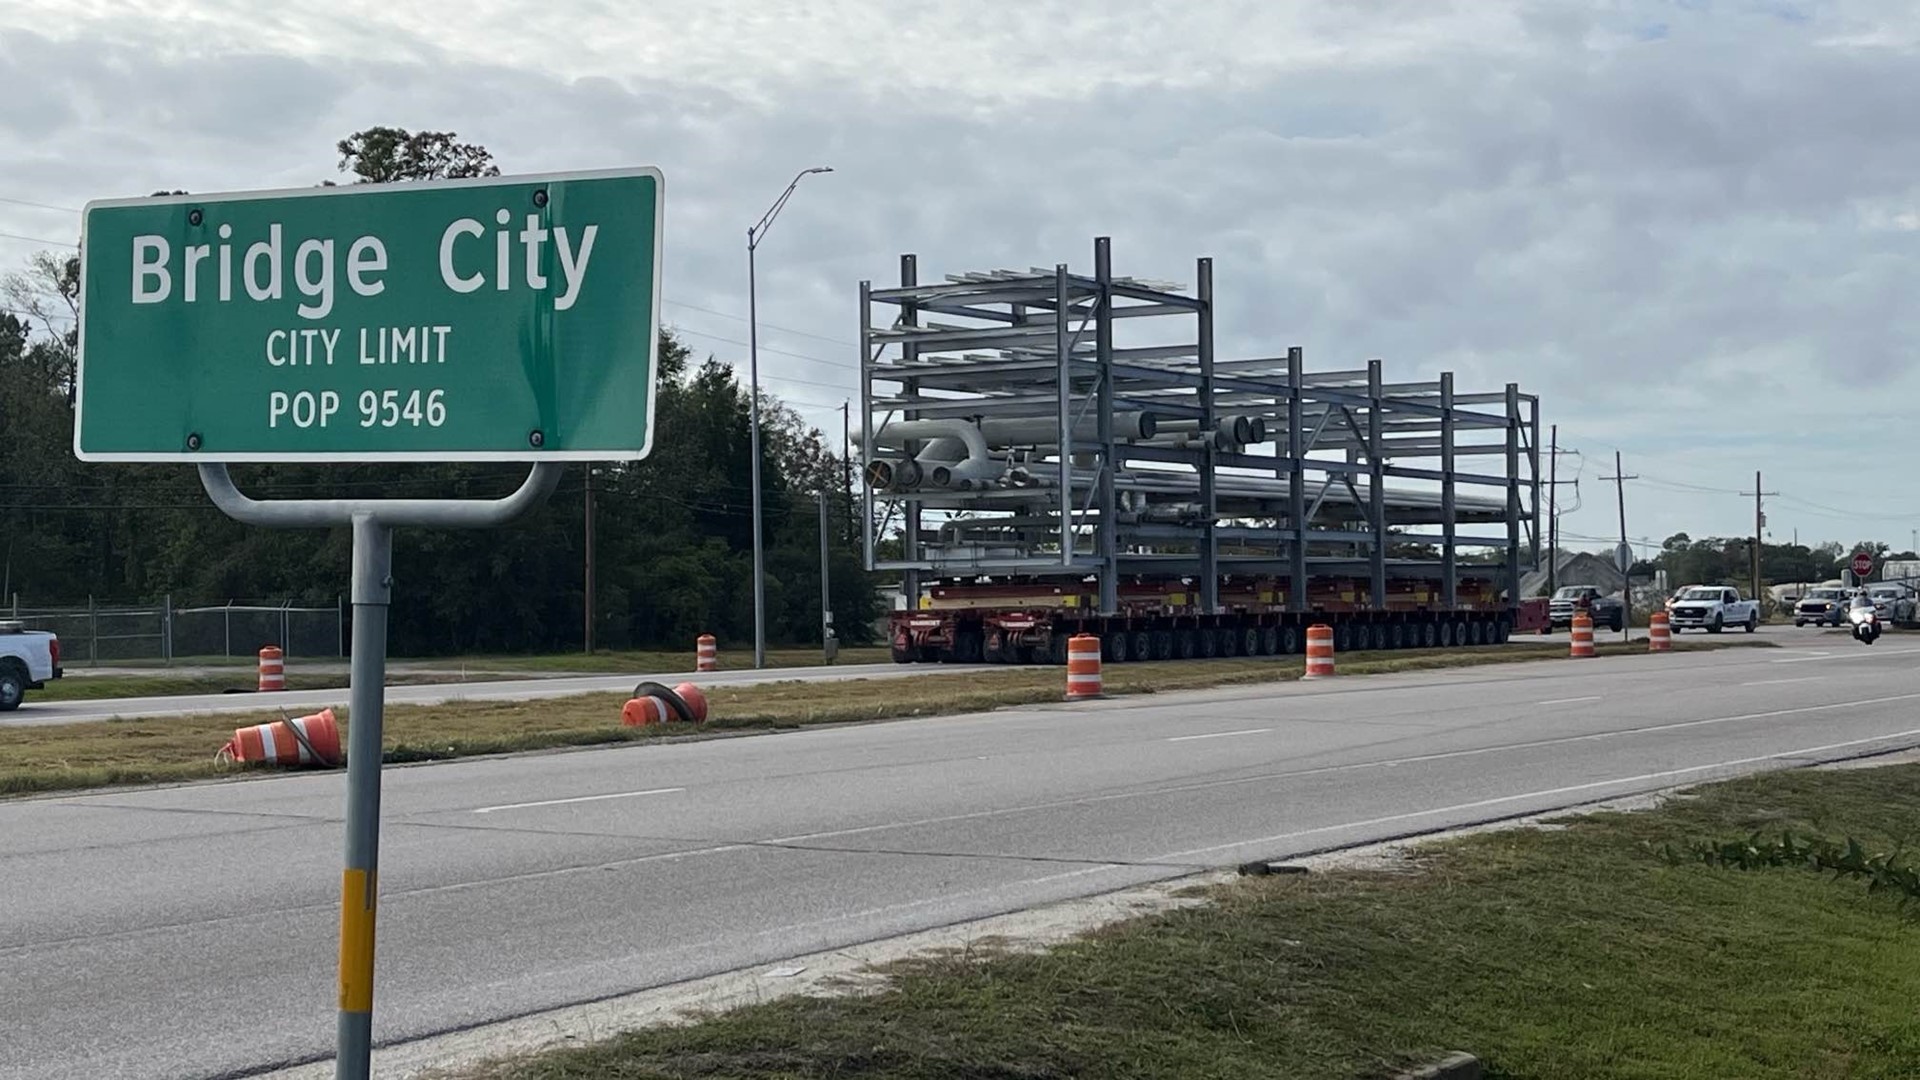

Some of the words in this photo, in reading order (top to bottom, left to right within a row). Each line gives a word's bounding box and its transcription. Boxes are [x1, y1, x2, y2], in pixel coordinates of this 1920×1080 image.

[132, 223, 388, 320] Bridge
[439, 208, 598, 310] City
[266, 328, 341, 366] CITY
[360, 326, 452, 365] LIMIT
[270, 391, 340, 428] POP
[359, 390, 447, 428] 9546
[1854, 560, 1872, 570] STOP
